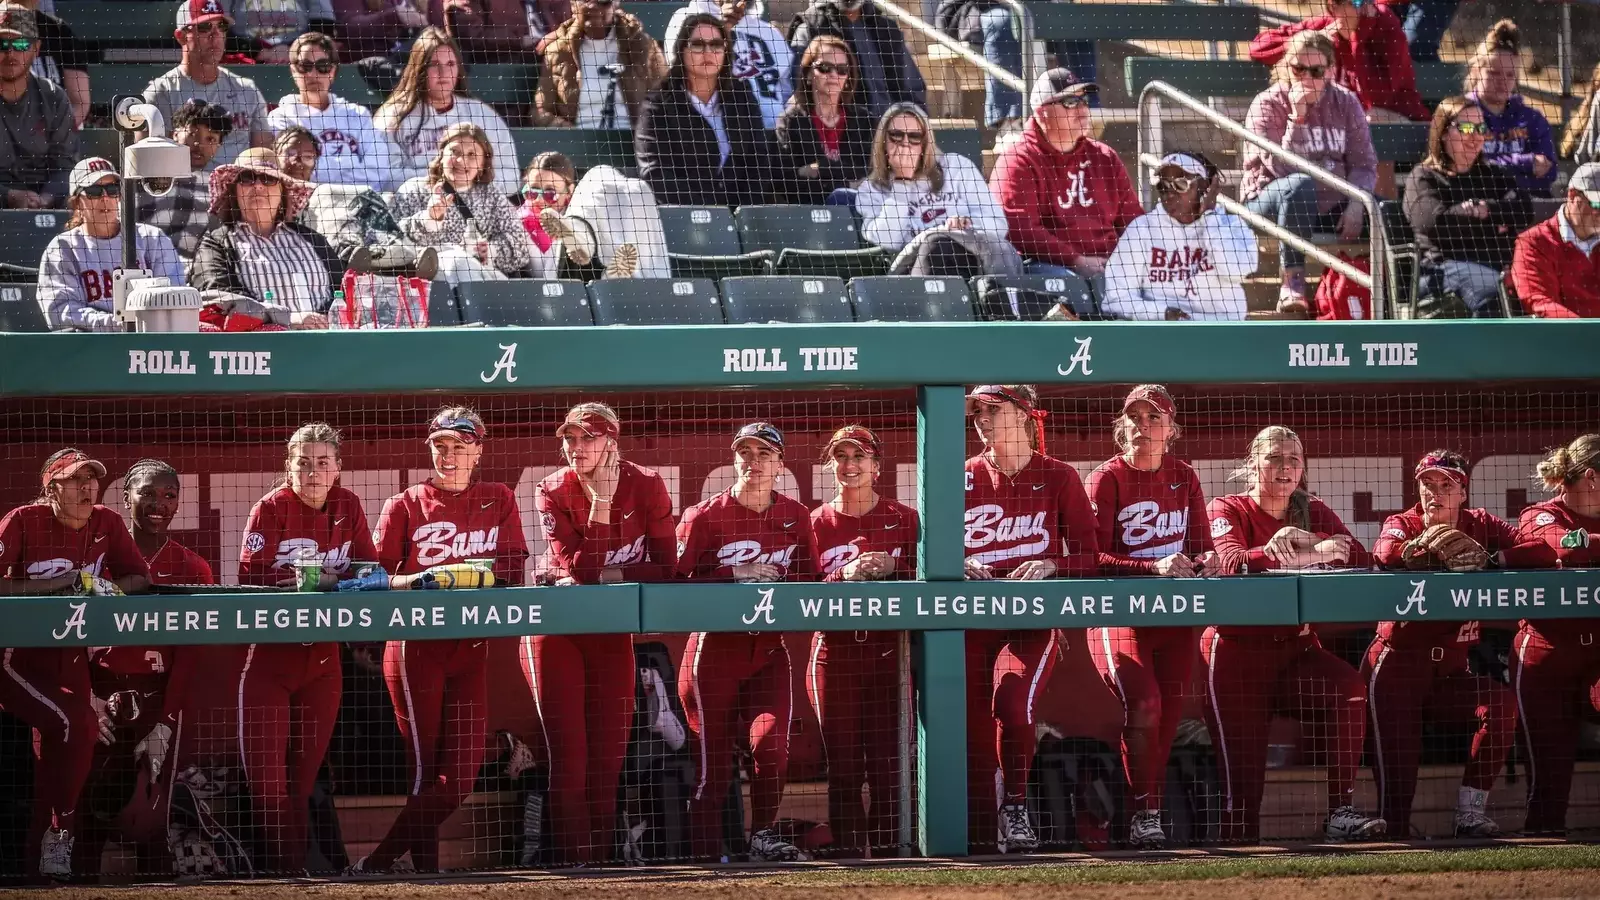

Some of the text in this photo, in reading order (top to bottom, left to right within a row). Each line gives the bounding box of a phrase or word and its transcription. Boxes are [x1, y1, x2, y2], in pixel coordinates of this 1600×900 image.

[129, 350, 271, 375] ROLL TIDE
[480, 342, 518, 383] A
[723, 347, 858, 372] ROLL TIDE
[1057, 336, 1093, 376] A
[1288, 342, 1418, 367] ROLL TIDE
[246, 533, 264, 552] SEC
[412, 521, 499, 566] Bama
[965, 504, 1048, 549] Bama
[741, 587, 1206, 625] A WHERE LEGENDS ARE MADE
[1396, 579, 1428, 616] A
[1450, 587, 1545, 607] WHERE
[52, 601, 542, 640] A WHERE LEGENDS ARE MADE
